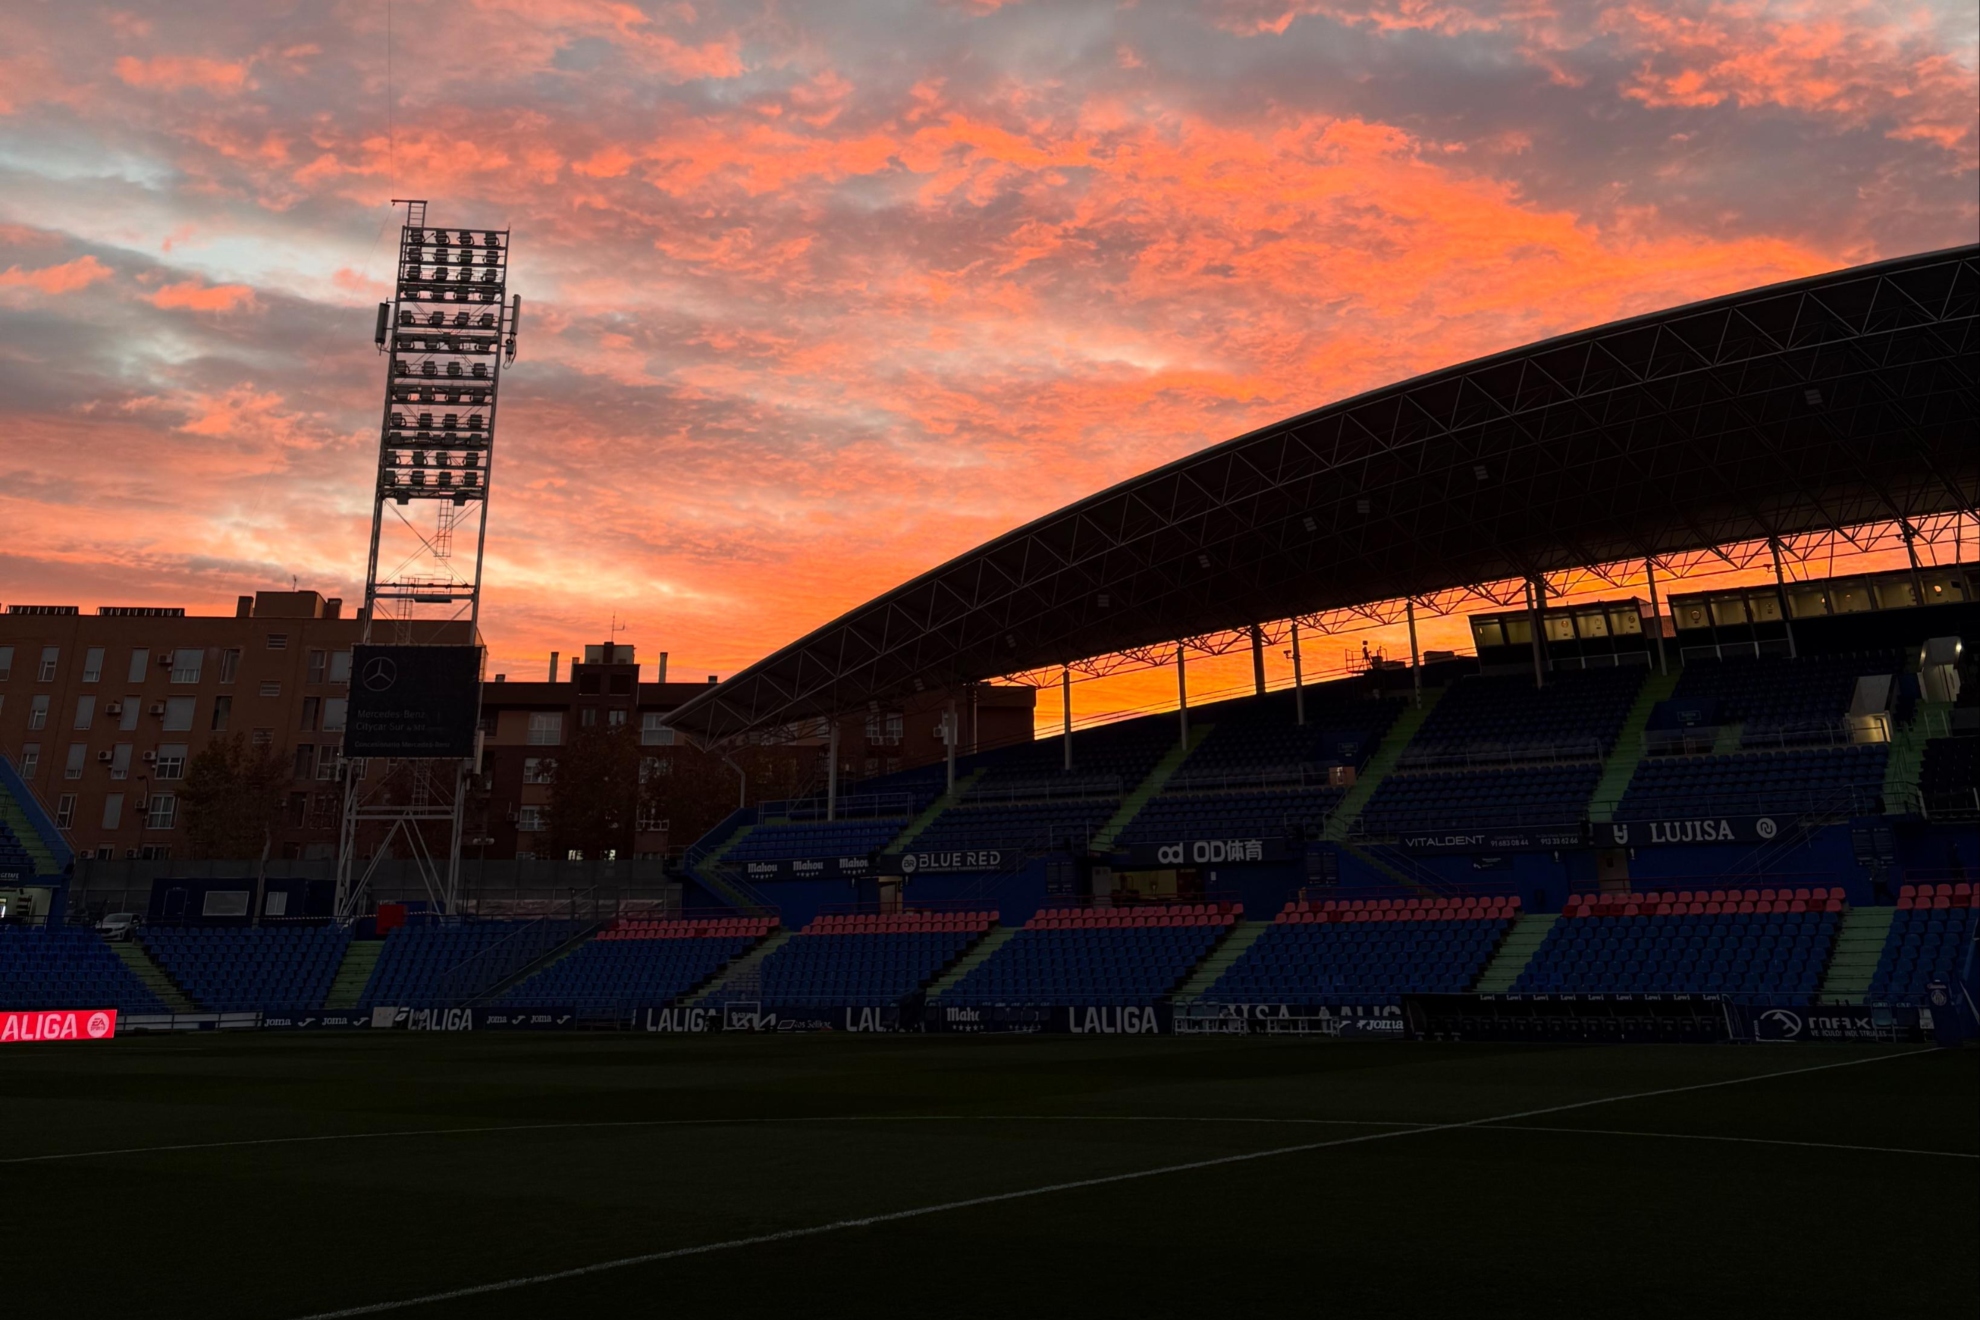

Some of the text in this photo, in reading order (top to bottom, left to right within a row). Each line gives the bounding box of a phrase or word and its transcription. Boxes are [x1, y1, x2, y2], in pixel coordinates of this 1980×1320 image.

[1650, 819, 1735, 843] LUJISA
[1405, 835, 1485, 847] VITALDENT
[793, 860, 824, 871] Mahou
[919, 850, 1001, 868] BLUE RED
[748, 862, 778, 873] Mahou
[1068, 1006, 1160, 1034] LALIGA
